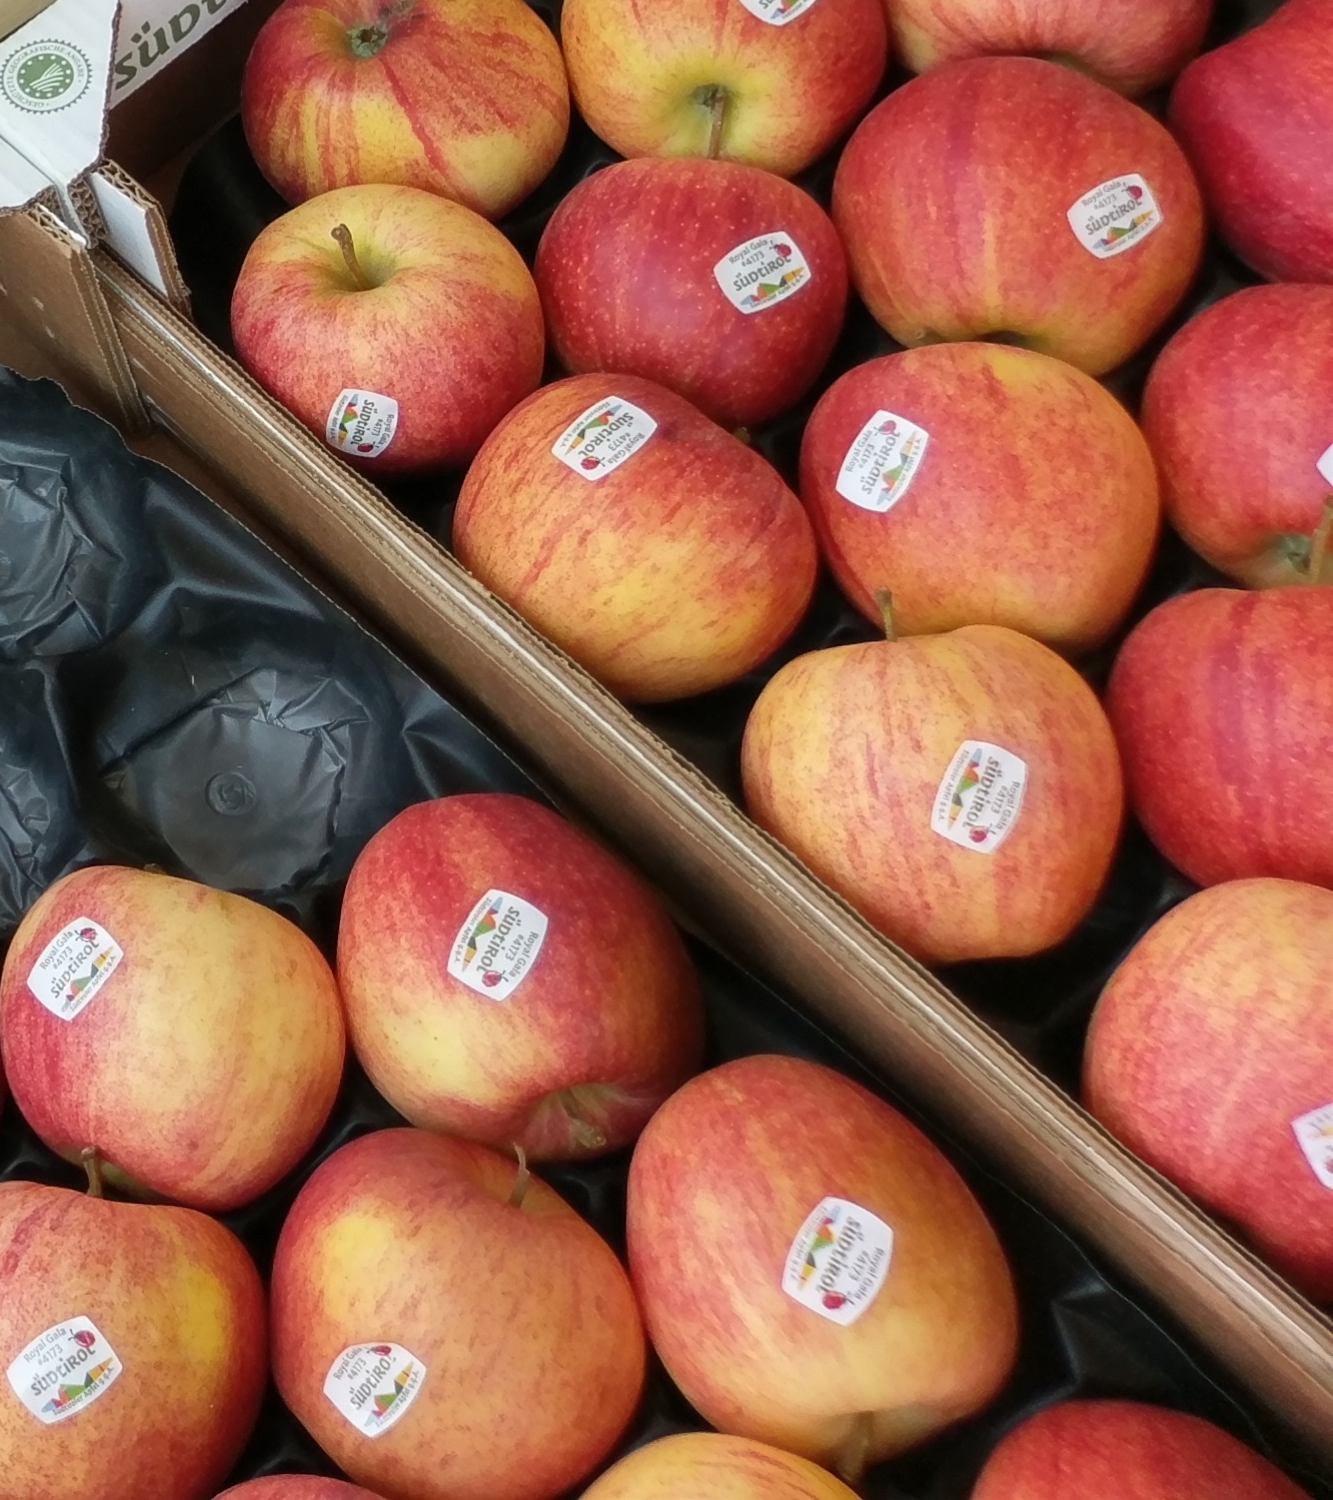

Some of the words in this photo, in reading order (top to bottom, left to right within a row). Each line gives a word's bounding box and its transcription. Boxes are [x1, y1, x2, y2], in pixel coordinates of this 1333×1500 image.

[1081, 189, 1103, 206] Royal
[1102, 181, 1121, 192] Gala
[728, 246, 750, 264] Royal
[749, 239, 768, 250] Gala
[741, 250, 764, 266] #4173
[383, 413, 394, 431] Royal
[377, 432, 389, 444] Gala
[607, 432, 630, 451] #4173
[623, 432, 644, 451] Royal
[606, 449, 625, 463] Gala
[845, 447, 861, 472] Royal
[857, 429, 872, 447] Gala
[991, 785, 1007, 813] #4173
[1006, 781, 1020, 808] Royal
[995, 809, 1011, 829] Gala
[39, 945, 58, 969] Royal
[56, 930, 73, 947] Gala
[505, 933, 524, 961] #4173
[521, 931, 539, 958] Royal
[52, 945, 72, 969] #4173
[508, 957, 526, 977] Gala
[23, 1339, 46, 1362] Royal
[45, 1328, 66, 1343] Gala
[37, 1343, 63, 1365] #4173
[332, 1358, 350, 1379] Royal
[346, 1347, 362, 1359] Gala
[347, 1357, 366, 1379] #4173
